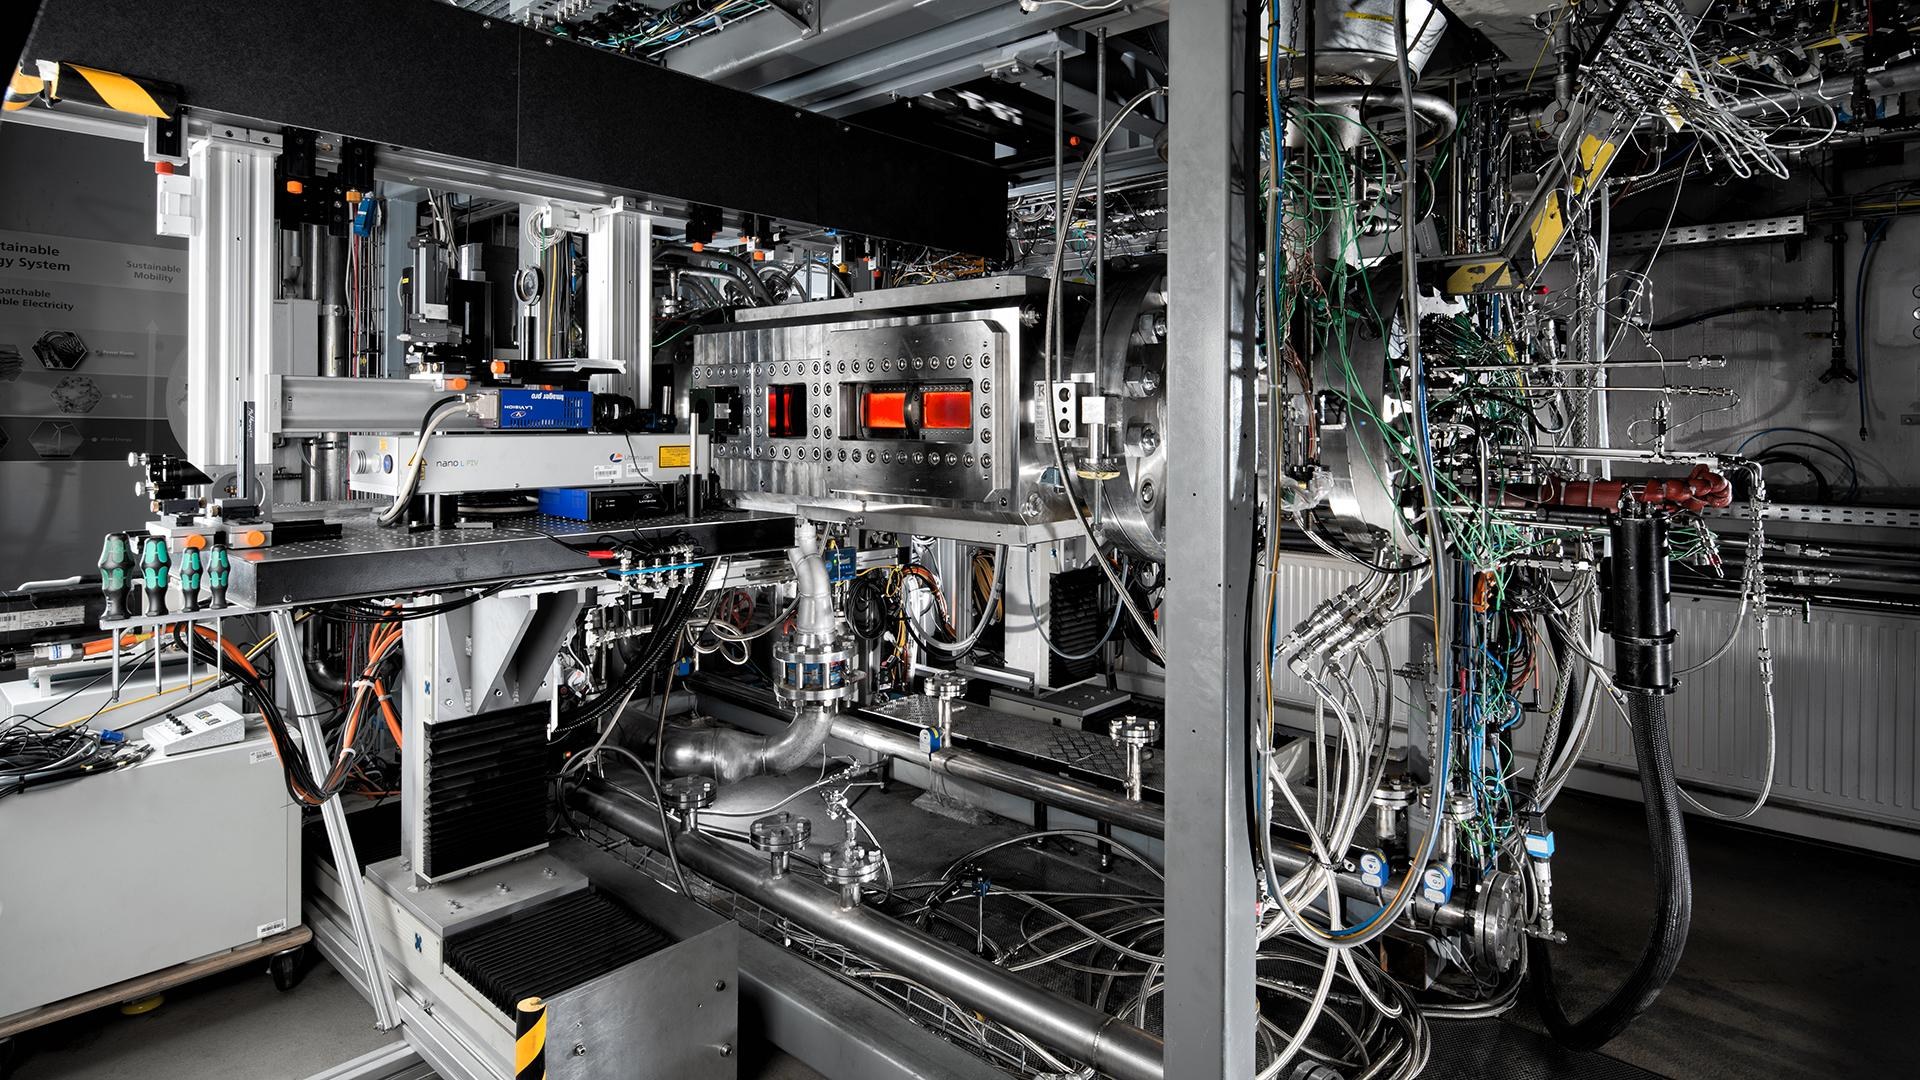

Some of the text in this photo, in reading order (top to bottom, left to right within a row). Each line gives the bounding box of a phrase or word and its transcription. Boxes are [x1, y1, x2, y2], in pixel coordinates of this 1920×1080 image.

[19, 257, 70, 271] System
[126, 261, 182, 273] Sustainable
[134, 271, 174, 283] Mobility
[22, 299, 74, 311] Electricity
